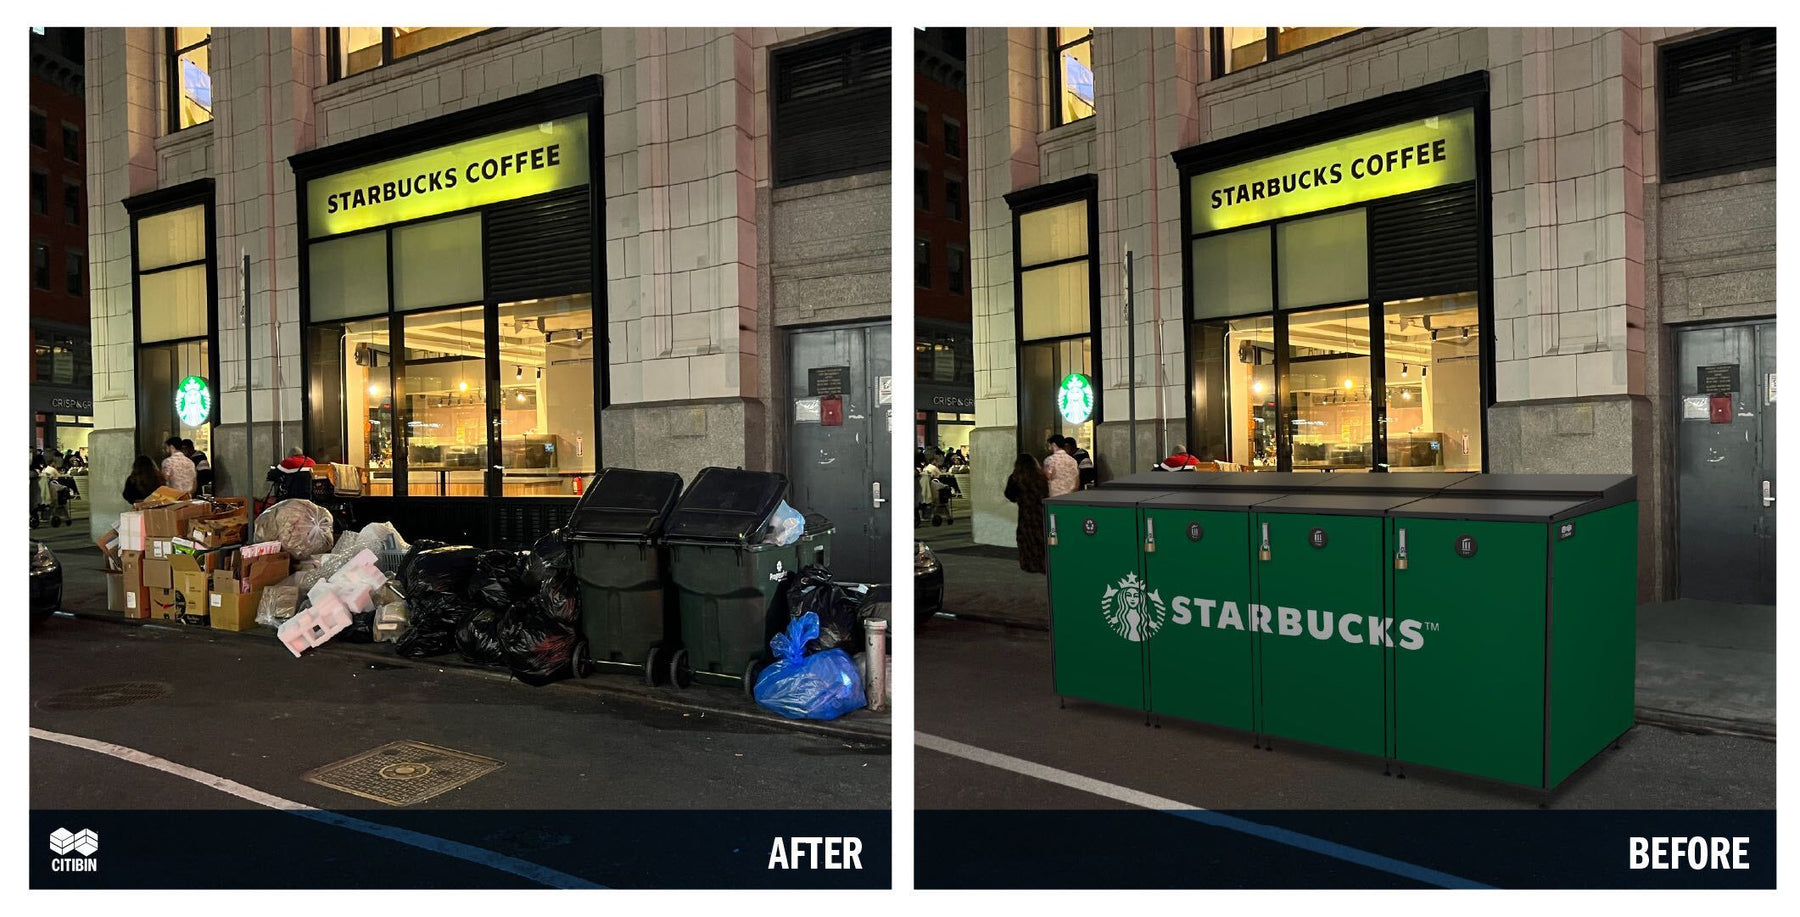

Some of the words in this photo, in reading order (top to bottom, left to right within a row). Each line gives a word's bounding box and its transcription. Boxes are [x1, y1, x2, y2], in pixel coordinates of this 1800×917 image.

[327, 162, 457, 214] STARBUCKS
[466, 143, 560, 184] COFFEE
[1211, 158, 1342, 209] STARBUCKS
[1351, 138, 1446, 180] COFFEE
[1171, 595, 1425, 651] STARBUCKS
